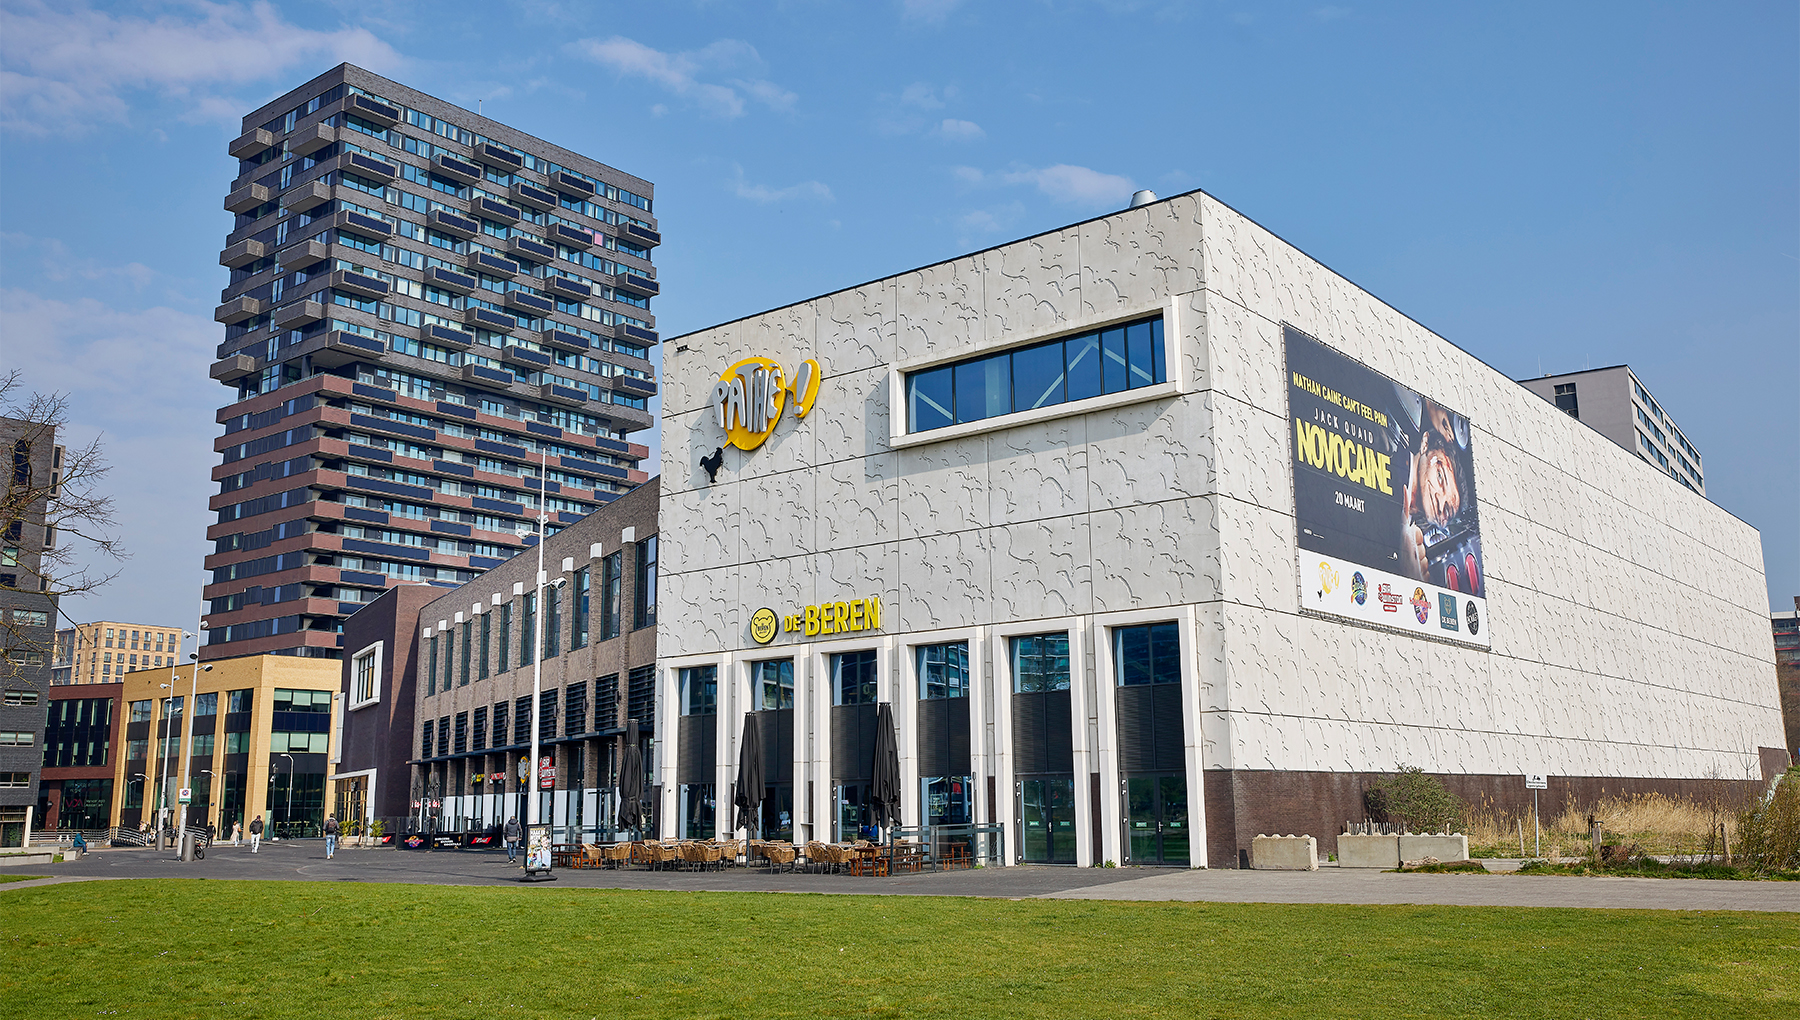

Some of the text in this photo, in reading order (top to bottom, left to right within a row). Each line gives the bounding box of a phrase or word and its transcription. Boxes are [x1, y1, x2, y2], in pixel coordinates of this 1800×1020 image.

[1293, 371, 1322, 397] NATHAN
[1322, 385, 1342, 407] CAINE
[1360, 403, 1374, 421] FEEL
[1373, 409, 1388, 428] PAIN
[1314, 408, 1374, 444] JACK QUAID
[1296, 417, 1393, 495] NOVOCAINE
[1335, 491, 1365, 513] 20 MAART
[784, 597, 881, 636] DE BEREN
